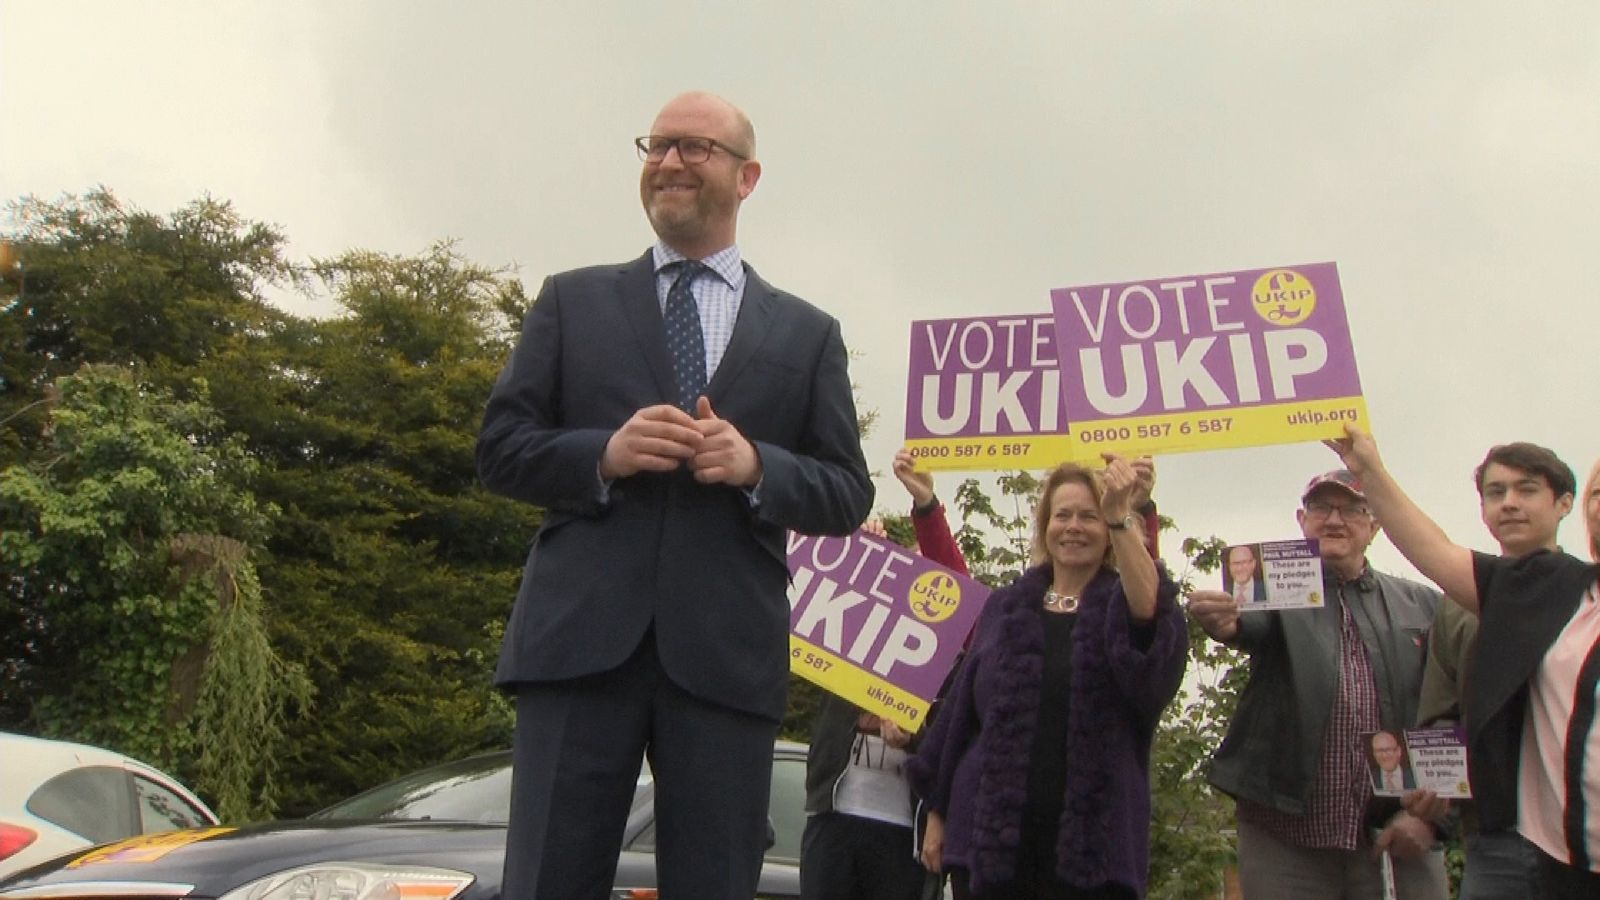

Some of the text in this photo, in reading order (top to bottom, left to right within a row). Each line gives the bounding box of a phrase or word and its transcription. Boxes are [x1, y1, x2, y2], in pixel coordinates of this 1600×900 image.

[1255, 289, 1312, 304] UKIP
[1070, 276, 1245, 343] VOTE
[926, 318, 1058, 370] VOTE
[1079, 328, 1328, 415] UKIP
[921, 369, 1060, 435] UKI
[1287, 407, 1358, 426] ukip.org
[1080, 418, 1233, 443] 0800 587 6 587
[910, 443, 1031, 458] 0800 587 6 587
[1283, 570, 1315, 579] pledges
[913, 582, 957, 607] UKIP
[803, 651, 834, 673] 587
[866, 684, 919, 720] ukip.org
